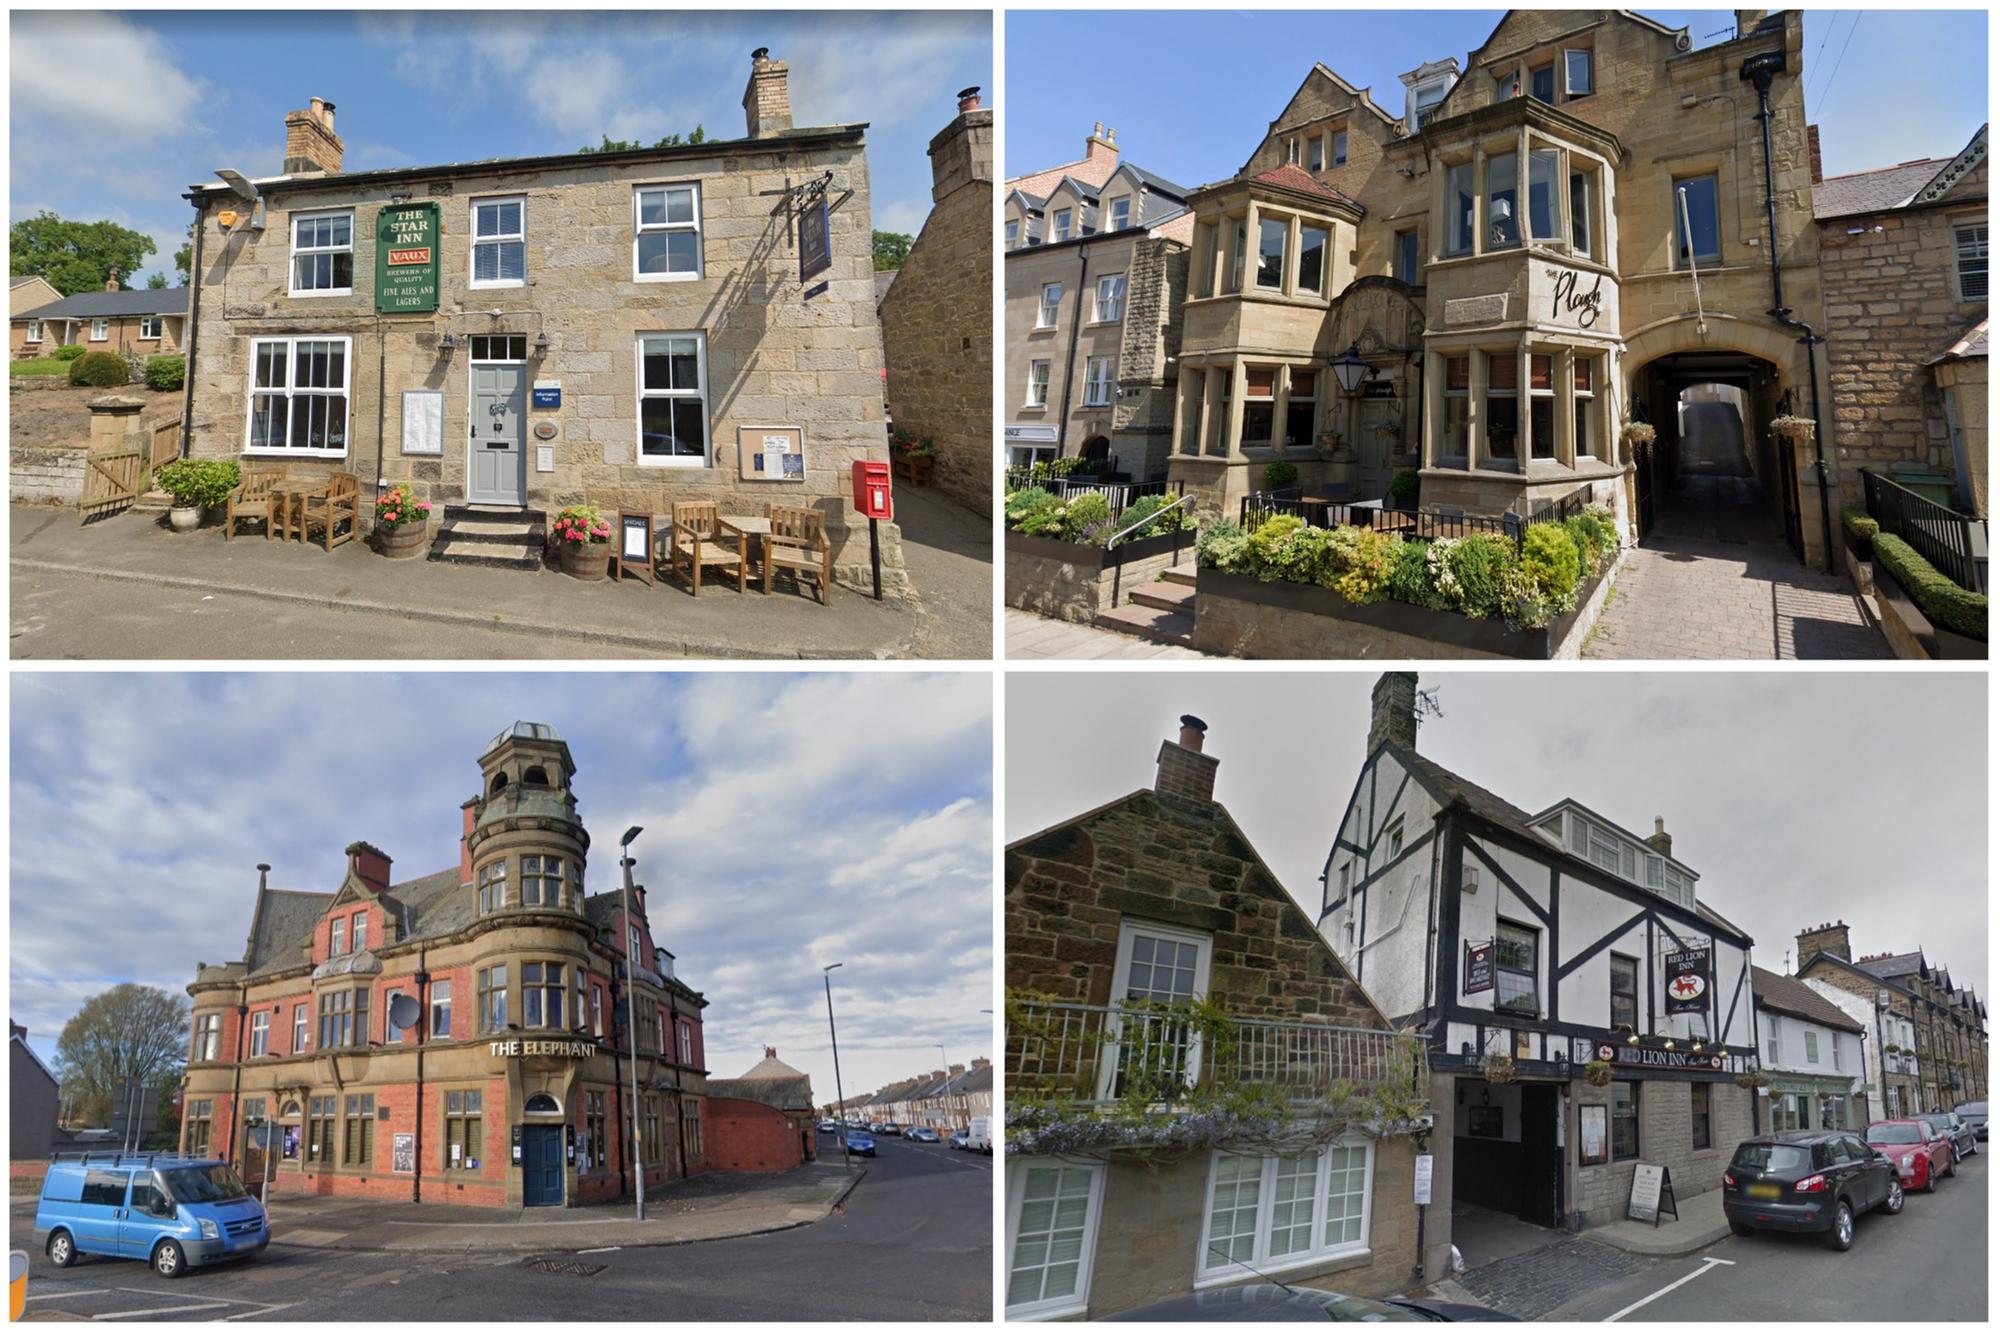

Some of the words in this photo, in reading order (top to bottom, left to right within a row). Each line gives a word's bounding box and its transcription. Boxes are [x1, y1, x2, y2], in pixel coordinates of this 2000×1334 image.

[396, 209, 424, 221] THE
[390, 220, 429, 233] STAR
[396, 232, 423, 244] INN
[391, 250, 428, 261] VAUX
[383, 287, 399, 296] FINE
[400, 287, 417, 296] ALES
[420, 286, 434, 295] AND
[395, 297, 421, 306] LAGERS
[1552, 270, 1602, 329] Plough
[1667, 954, 1684, 964] RED
[1685, 950, 1706, 961] LION
[1679, 960, 1695, 971] INN
[489, 1040, 520, 1057] THE
[522, 1041, 597, 1058] ELEPHANT
[1618, 1047, 1641, 1063] RED
[1642, 1050, 1667, 1065] LION
[1668, 1052, 1687, 1066] INN
